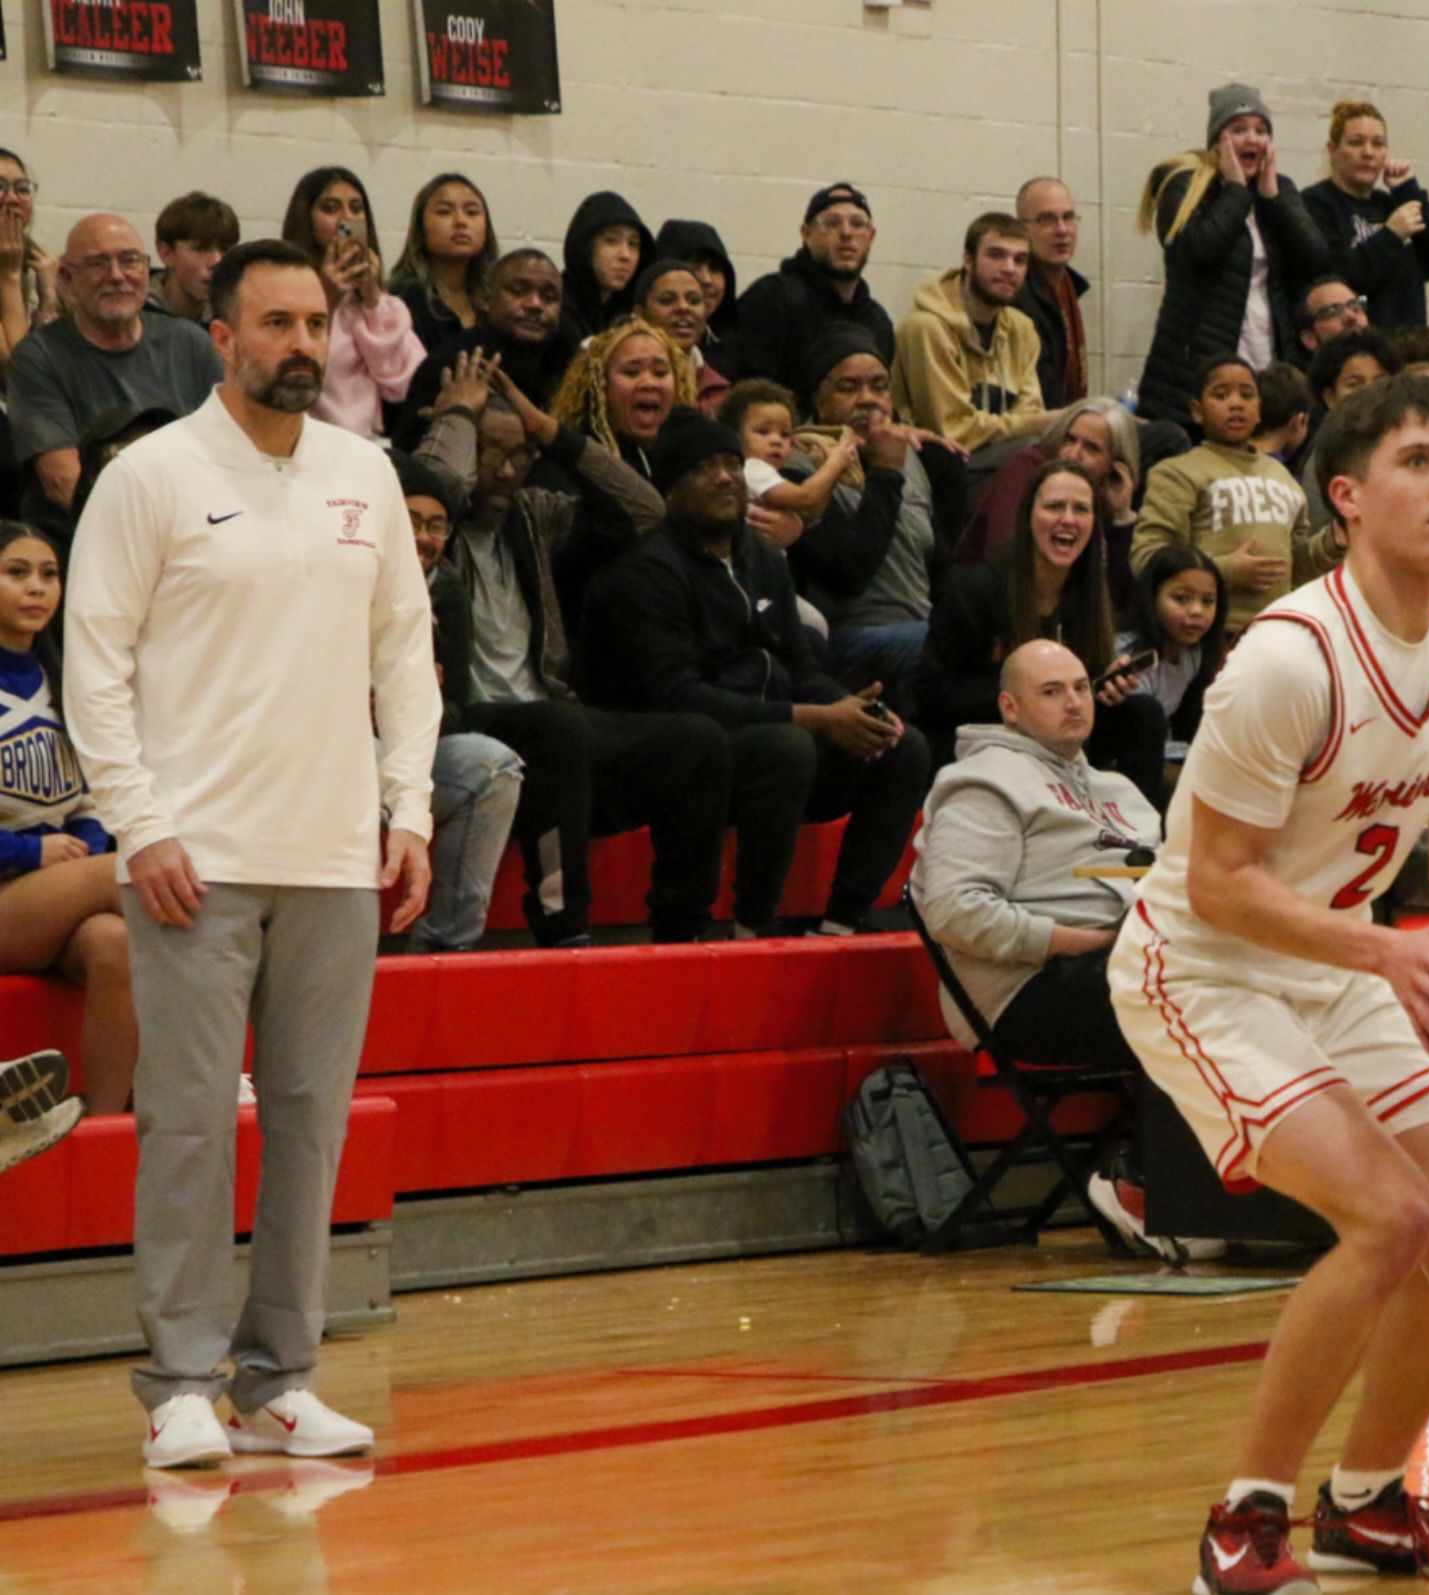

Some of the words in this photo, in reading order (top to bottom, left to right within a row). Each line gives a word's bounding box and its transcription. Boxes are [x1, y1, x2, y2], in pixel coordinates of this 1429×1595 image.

[53, 0, 174, 53] CALEER
[447, 14, 485, 44] CODY
[428, 32, 511, 89] WEISE
[1, 729, 90, 797] BROOKL
[1329, 822, 1399, 909] 2
